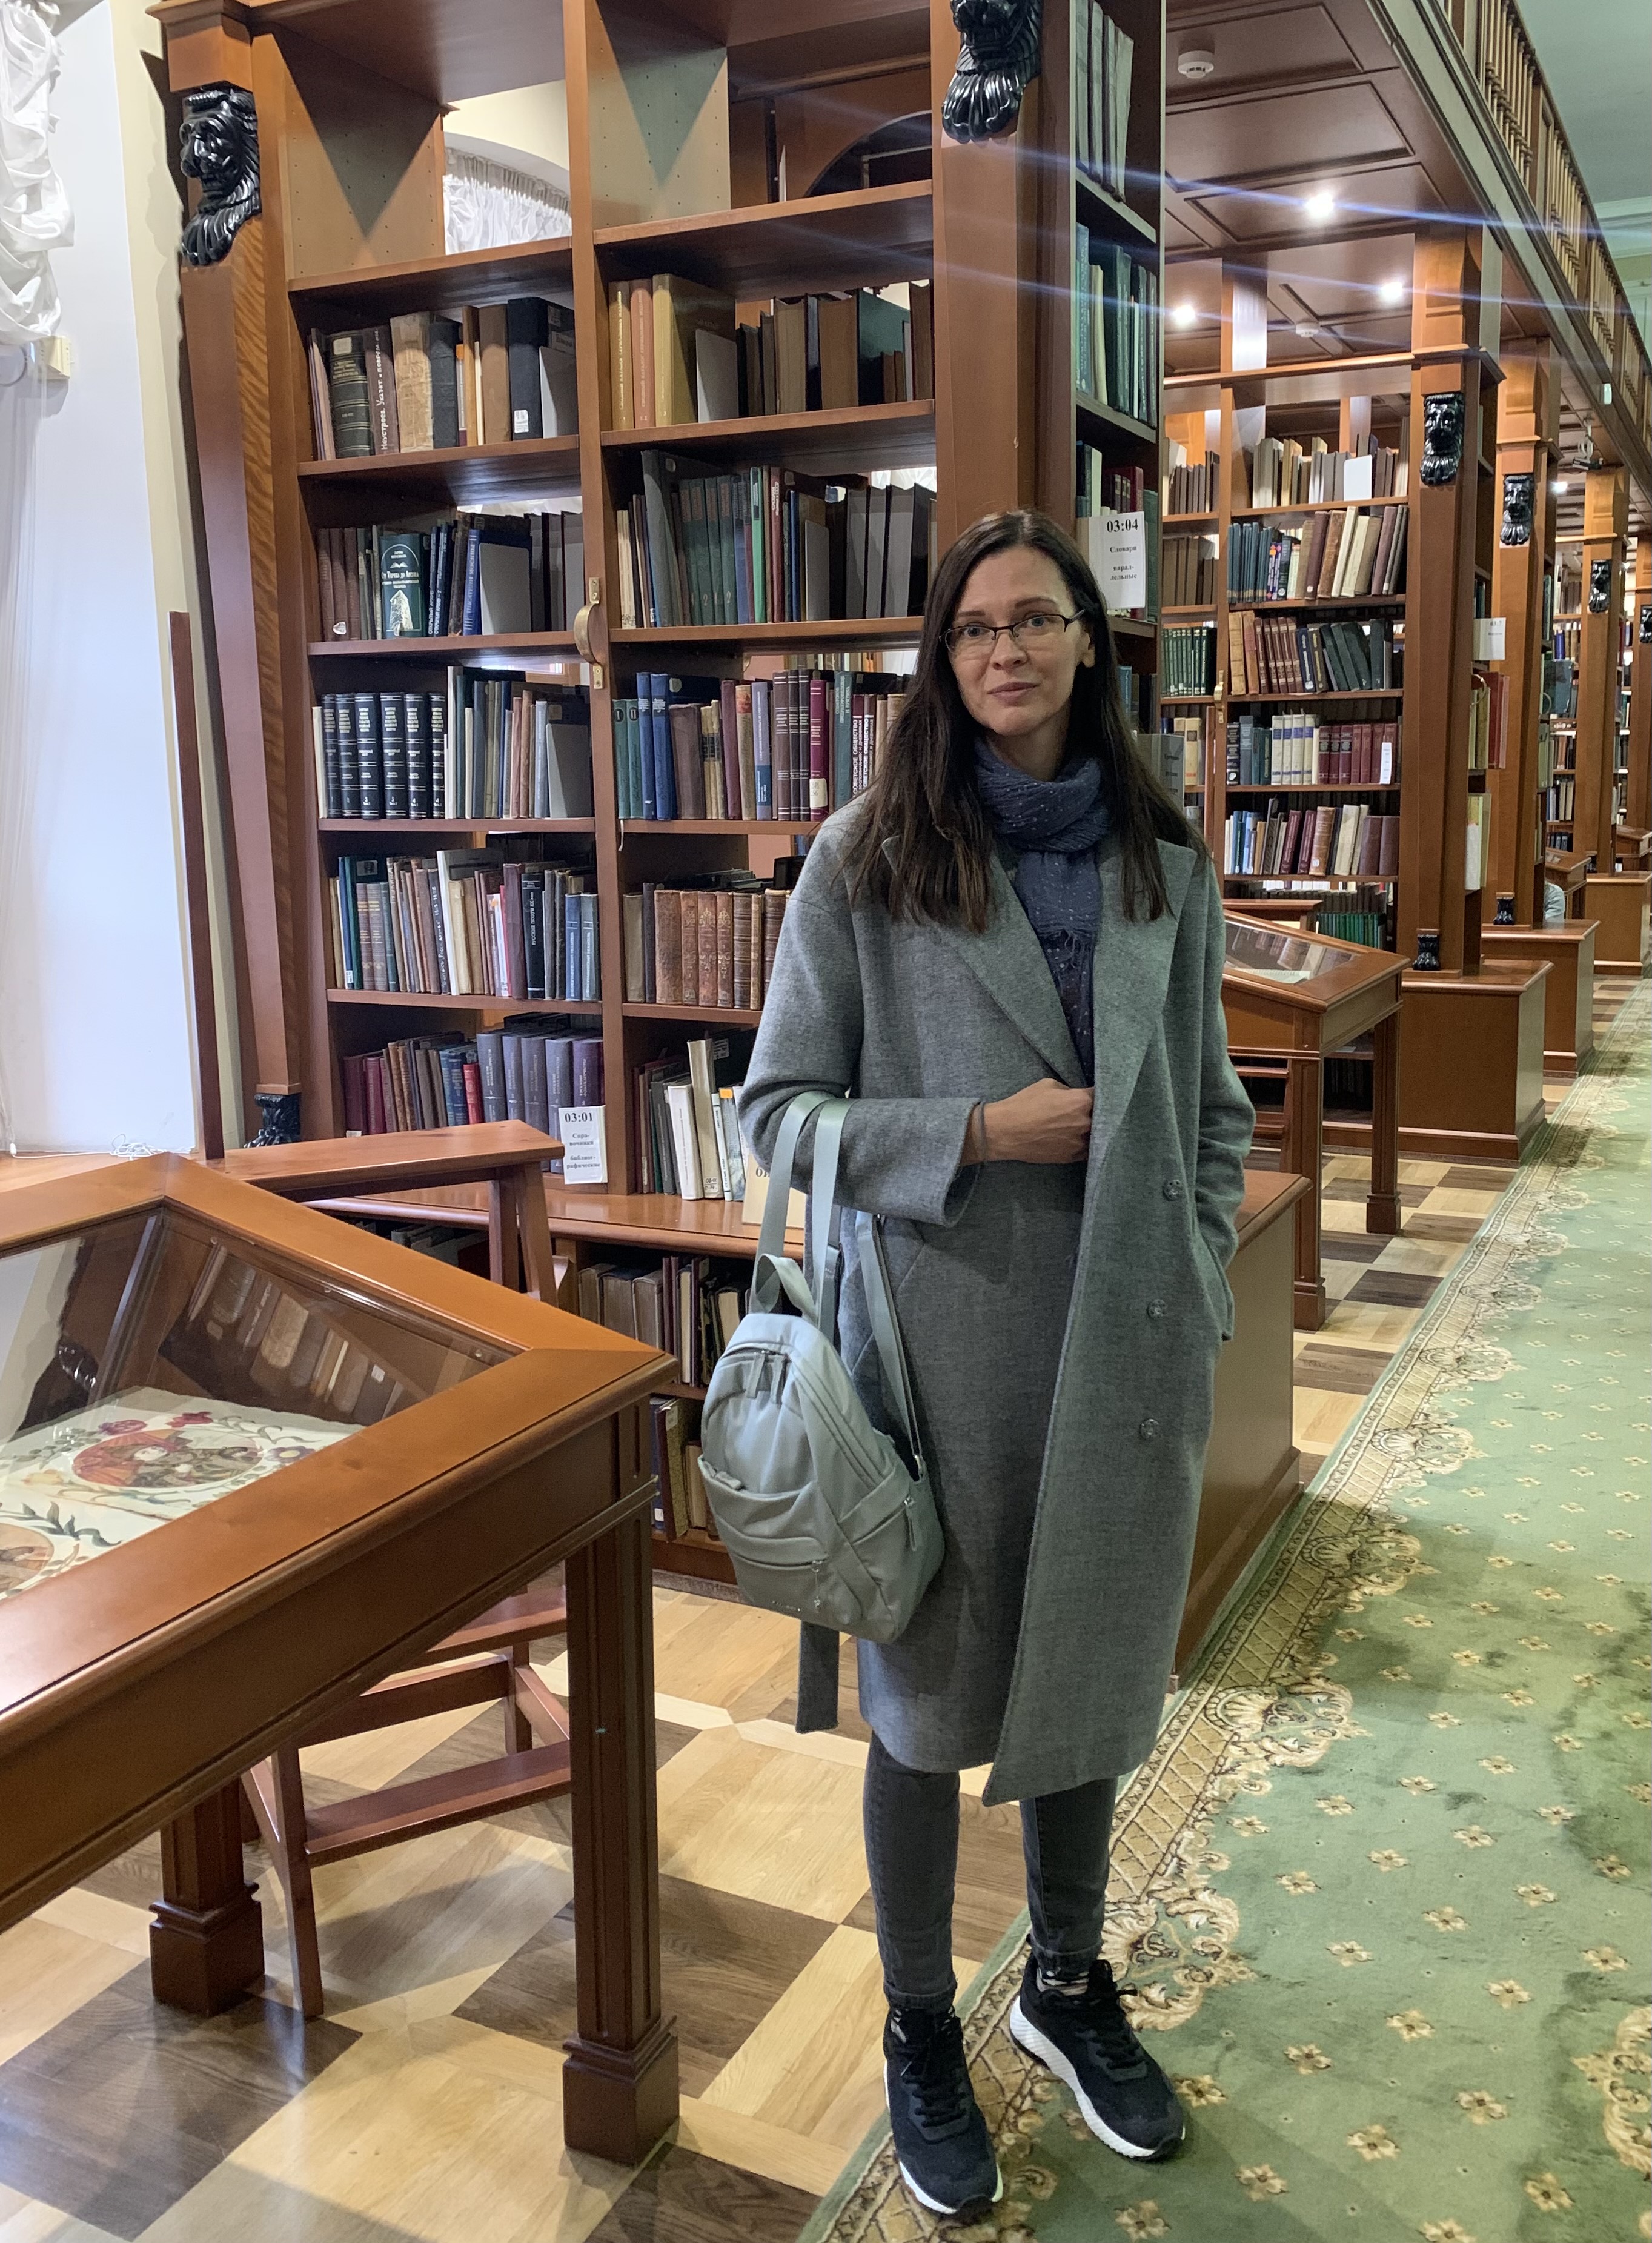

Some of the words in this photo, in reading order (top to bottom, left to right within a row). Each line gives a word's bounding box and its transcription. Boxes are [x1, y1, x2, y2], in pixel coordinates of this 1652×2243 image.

[1107, 518, 1138, 533] 03:04
[703, 594, 708, 606] 2
[726, 591, 731, 603] 2
[631, 709, 637, 719] II
[565, 1112, 593, 1123] 03:01
